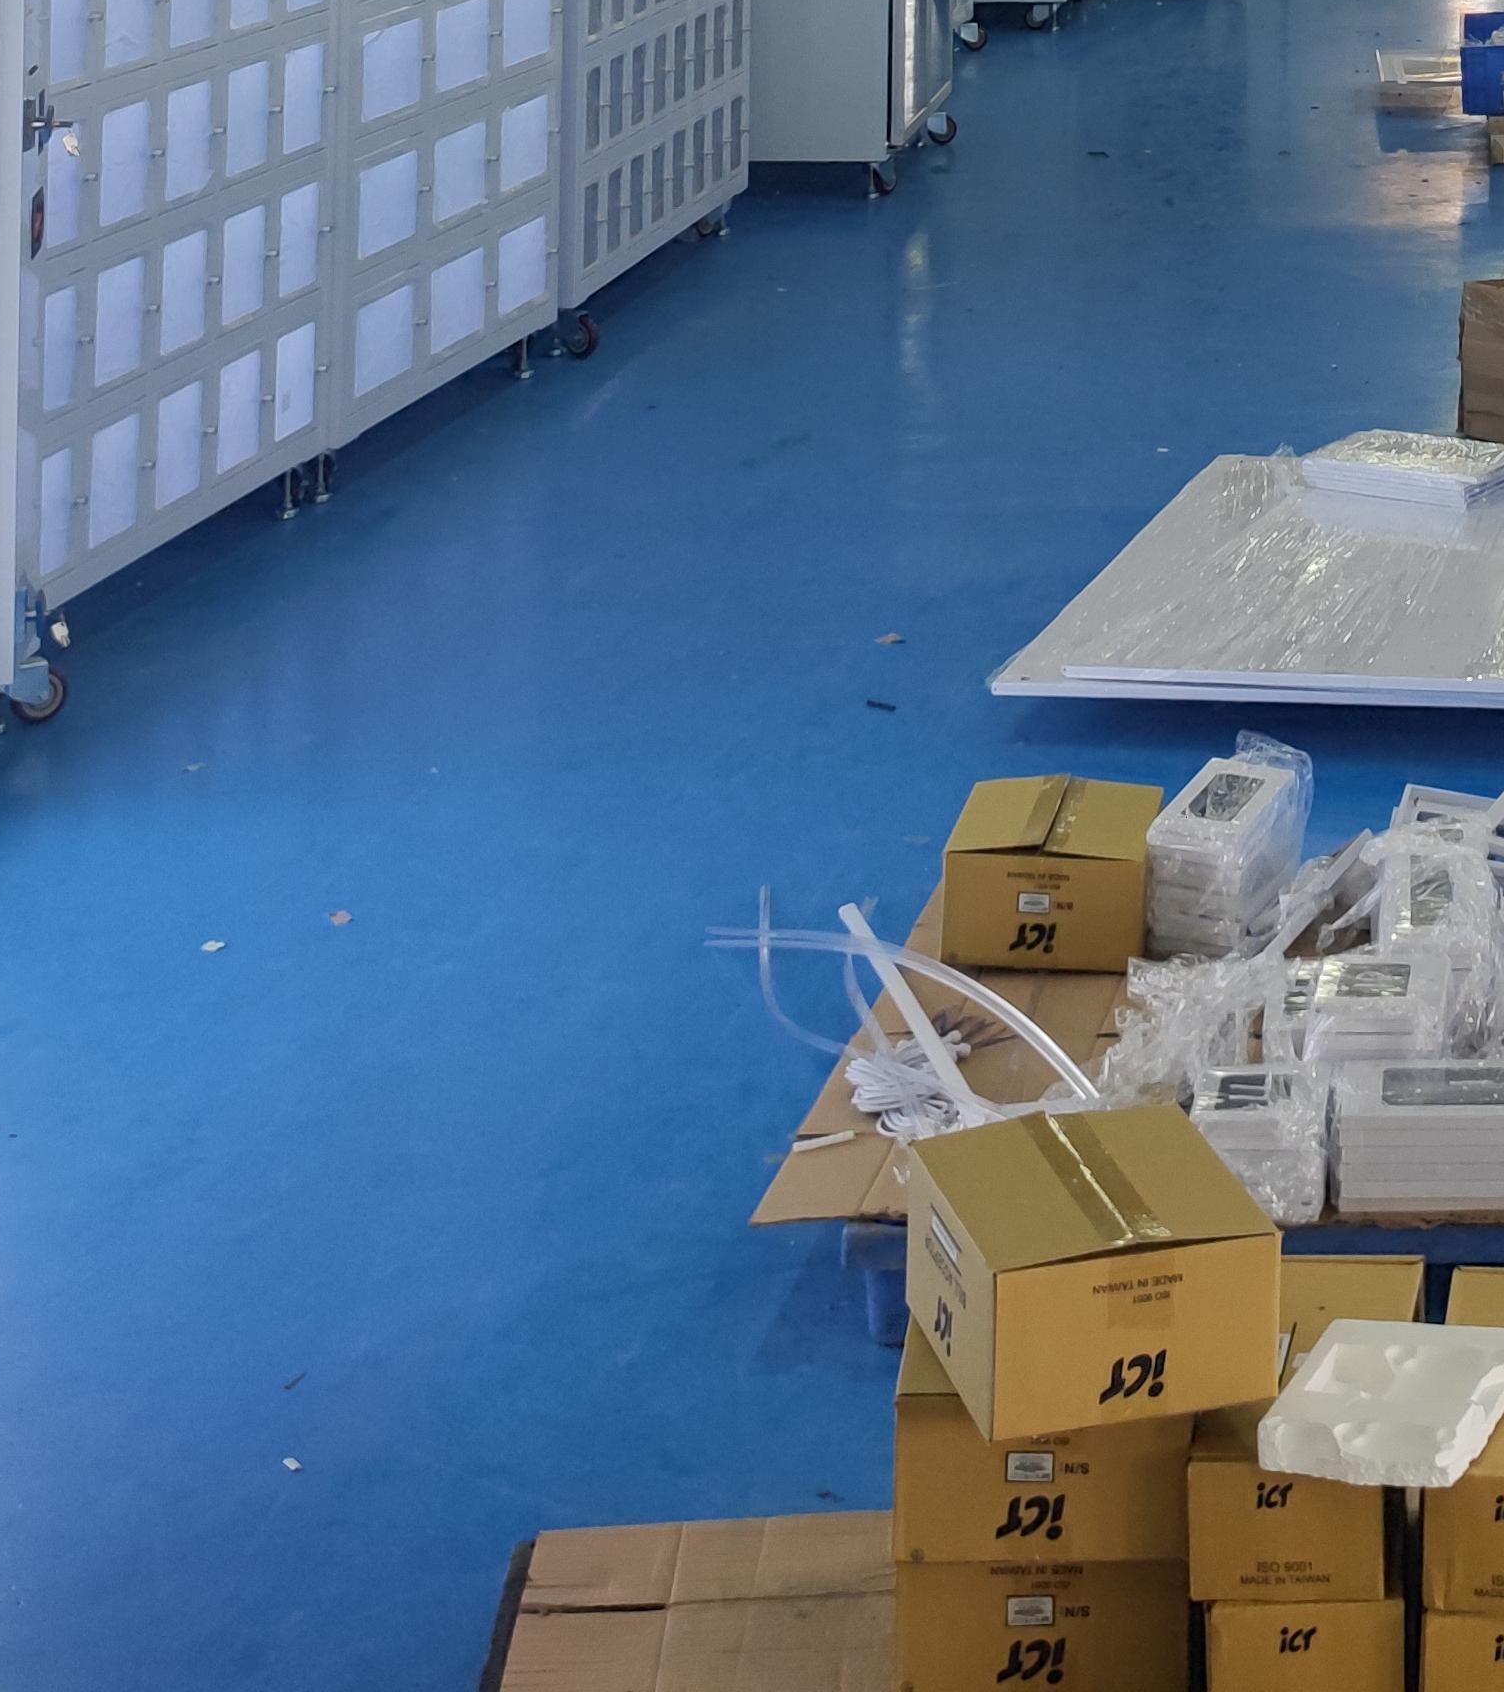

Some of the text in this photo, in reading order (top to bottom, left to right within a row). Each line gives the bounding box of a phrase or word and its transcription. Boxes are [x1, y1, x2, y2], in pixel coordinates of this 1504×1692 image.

[1137, 1278, 1149, 1289] IN
[1152, 1273, 1184, 1287] MADE
[1257, 1561, 1313, 1573] ISO 9001
[1240, 1573, 1331, 1585] MADE IN TAIWAN
